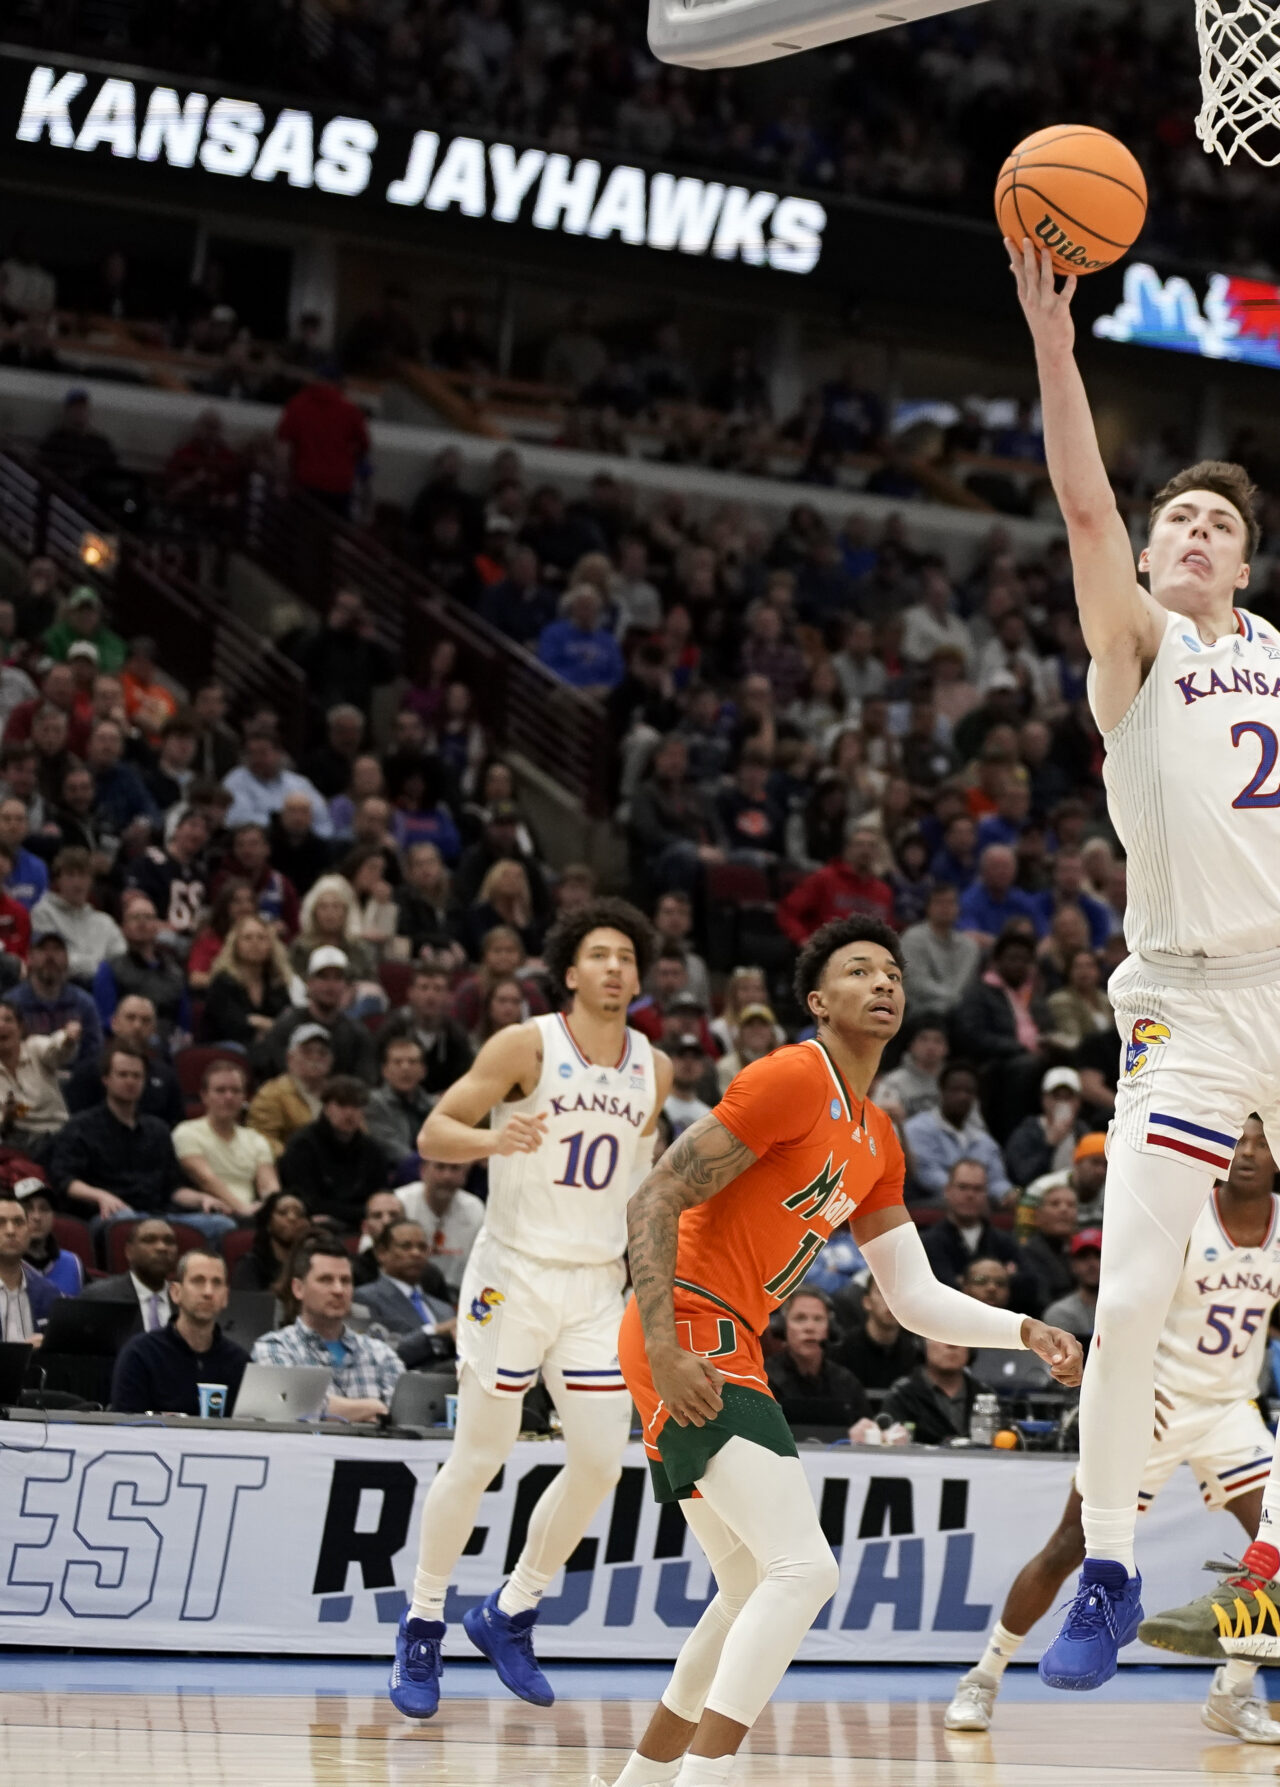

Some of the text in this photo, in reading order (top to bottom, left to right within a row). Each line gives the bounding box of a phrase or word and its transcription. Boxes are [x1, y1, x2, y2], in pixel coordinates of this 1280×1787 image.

[15, 65, 828, 275] KANSAS JAYHAWKS
[550, 1092, 645, 1127] KANSAS
[553, 1130, 619, 1191] 10
[781, 1151, 858, 1229] Miam
[763, 1228, 828, 1301] 11
[1197, 1304, 1266, 1359] 55
[312, 1459, 993, 1633] RGIAL
